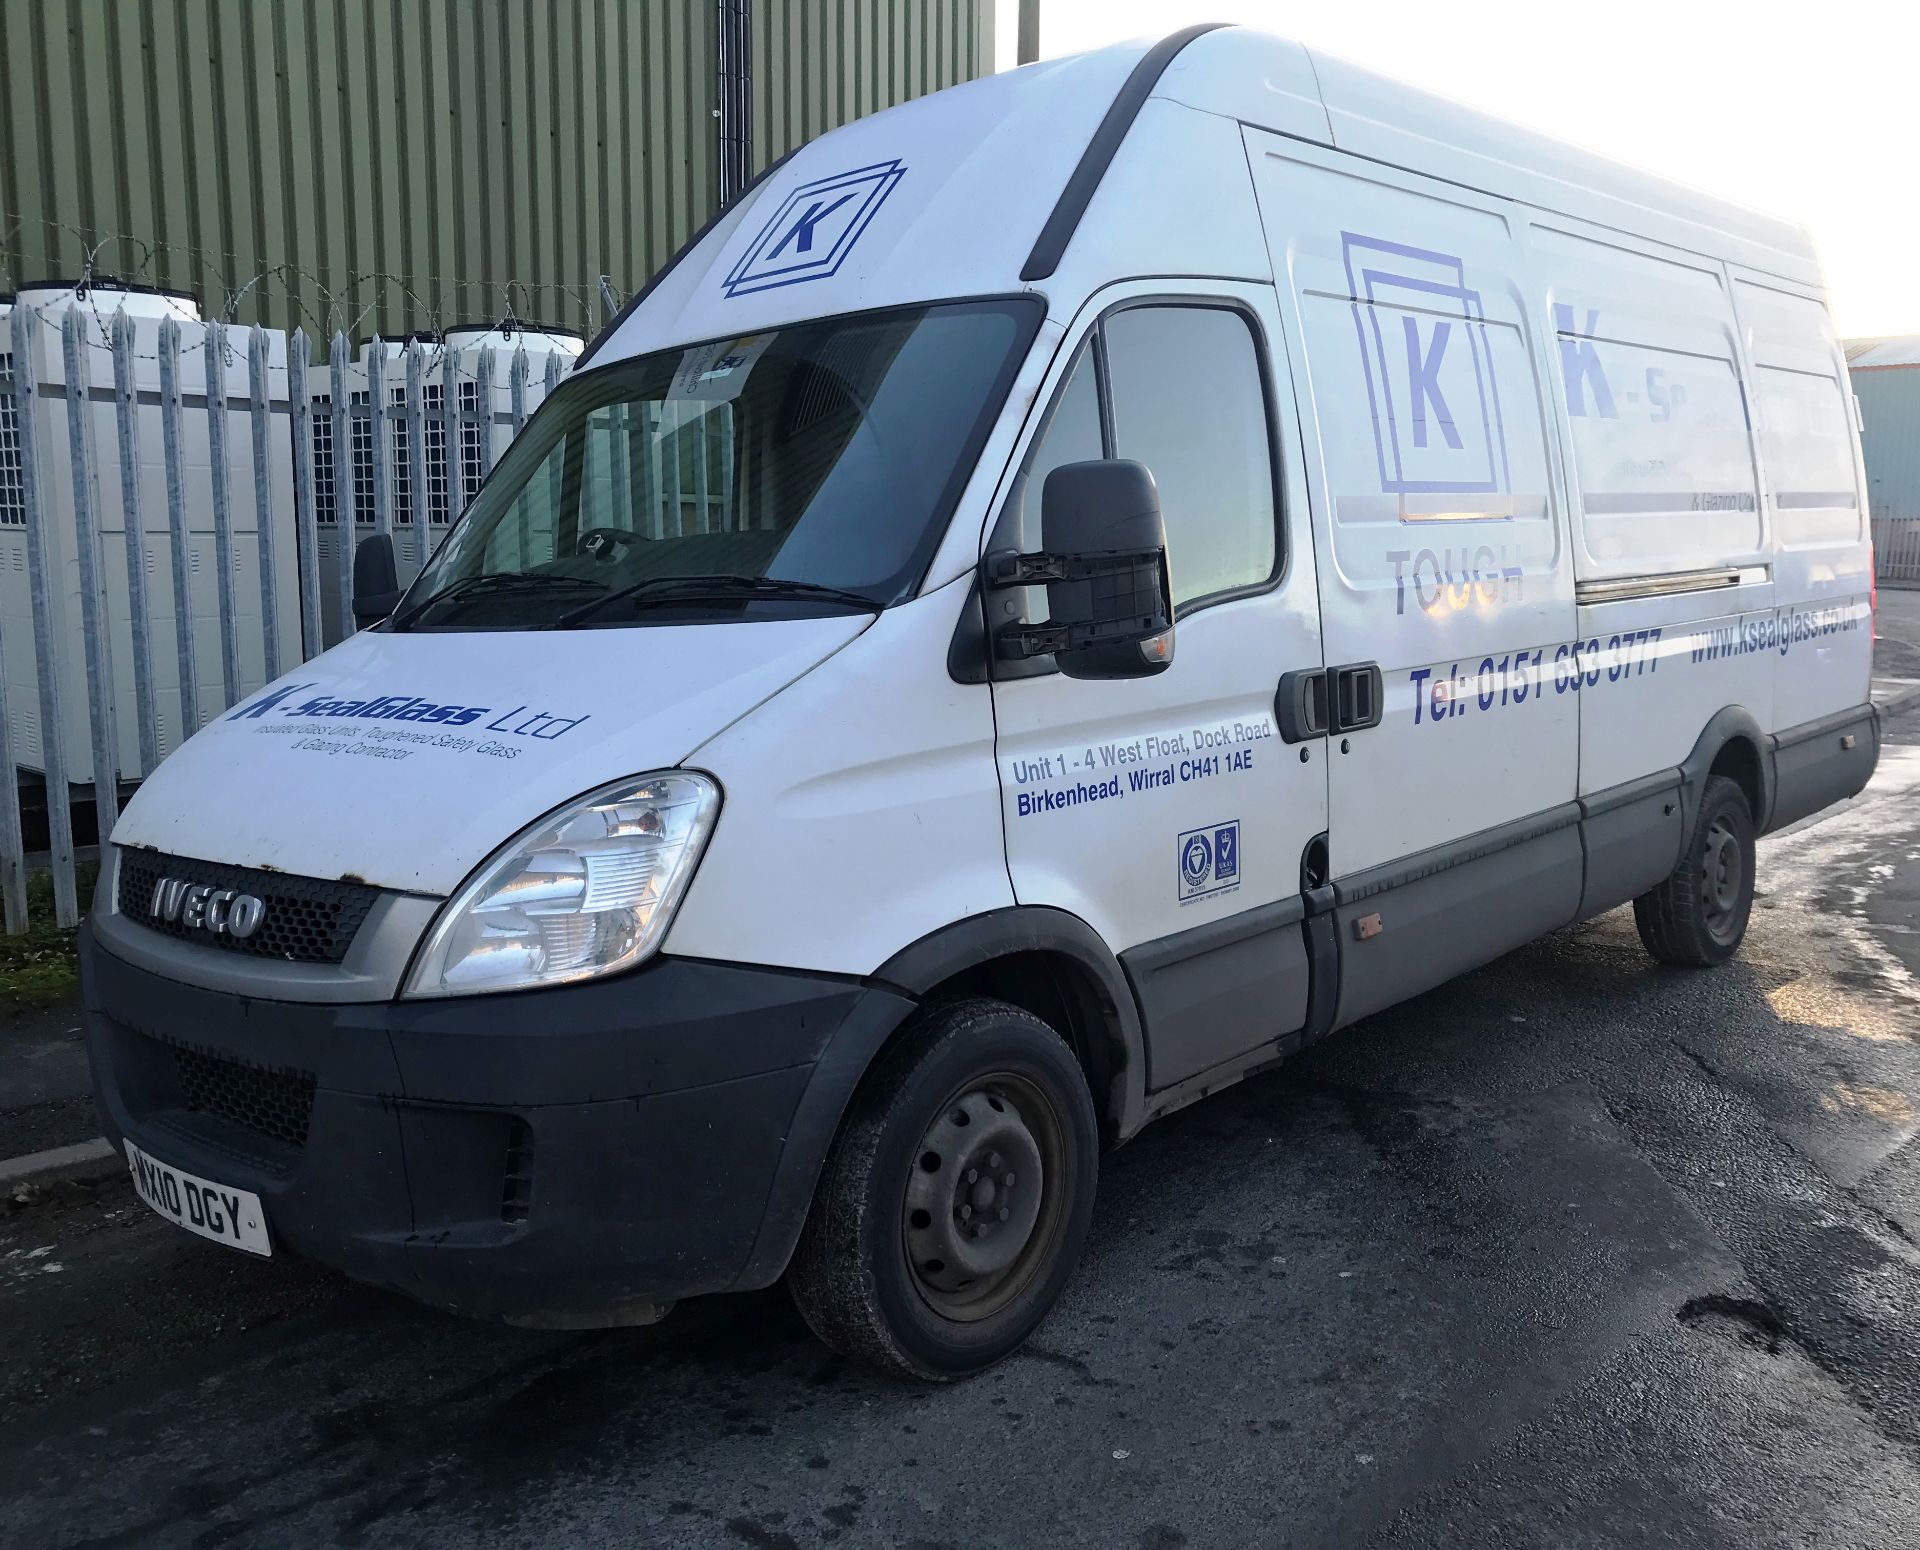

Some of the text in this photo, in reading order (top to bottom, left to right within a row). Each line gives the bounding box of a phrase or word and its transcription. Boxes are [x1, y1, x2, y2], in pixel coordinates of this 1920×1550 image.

[765, 192, 860, 260] K
[1402, 316, 1464, 450] K
[1410, 667, 1465, 725] Tel:
[1478, 649, 1543, 711] 0151
[1690, 597, 1858, 664] www.ksealglass.co.uk
[291, 738, 415, 760] & Glazing Contractor
[297, 723, 331, 735] Glass
[362, 726, 437, 744] Toughened
[432, 734, 480, 753] Safety
[476, 740, 522, 759] Glass
[485, 706, 592, 740] Ltd
[1012, 757, 1052, 784] Unit
[1084, 748, 1095, 770] 4
[1099, 742, 1143, 767] West
[1146, 736, 1190, 760] Float,
[1193, 725, 1231, 750] Dock
[1234, 719, 1271, 742] Road
[1017, 749, 1253, 816] Birkenhead, Wirral CH41 1AE
[150, 877, 266, 938] IVECO
[183, 1179, 241, 1240] DGY
